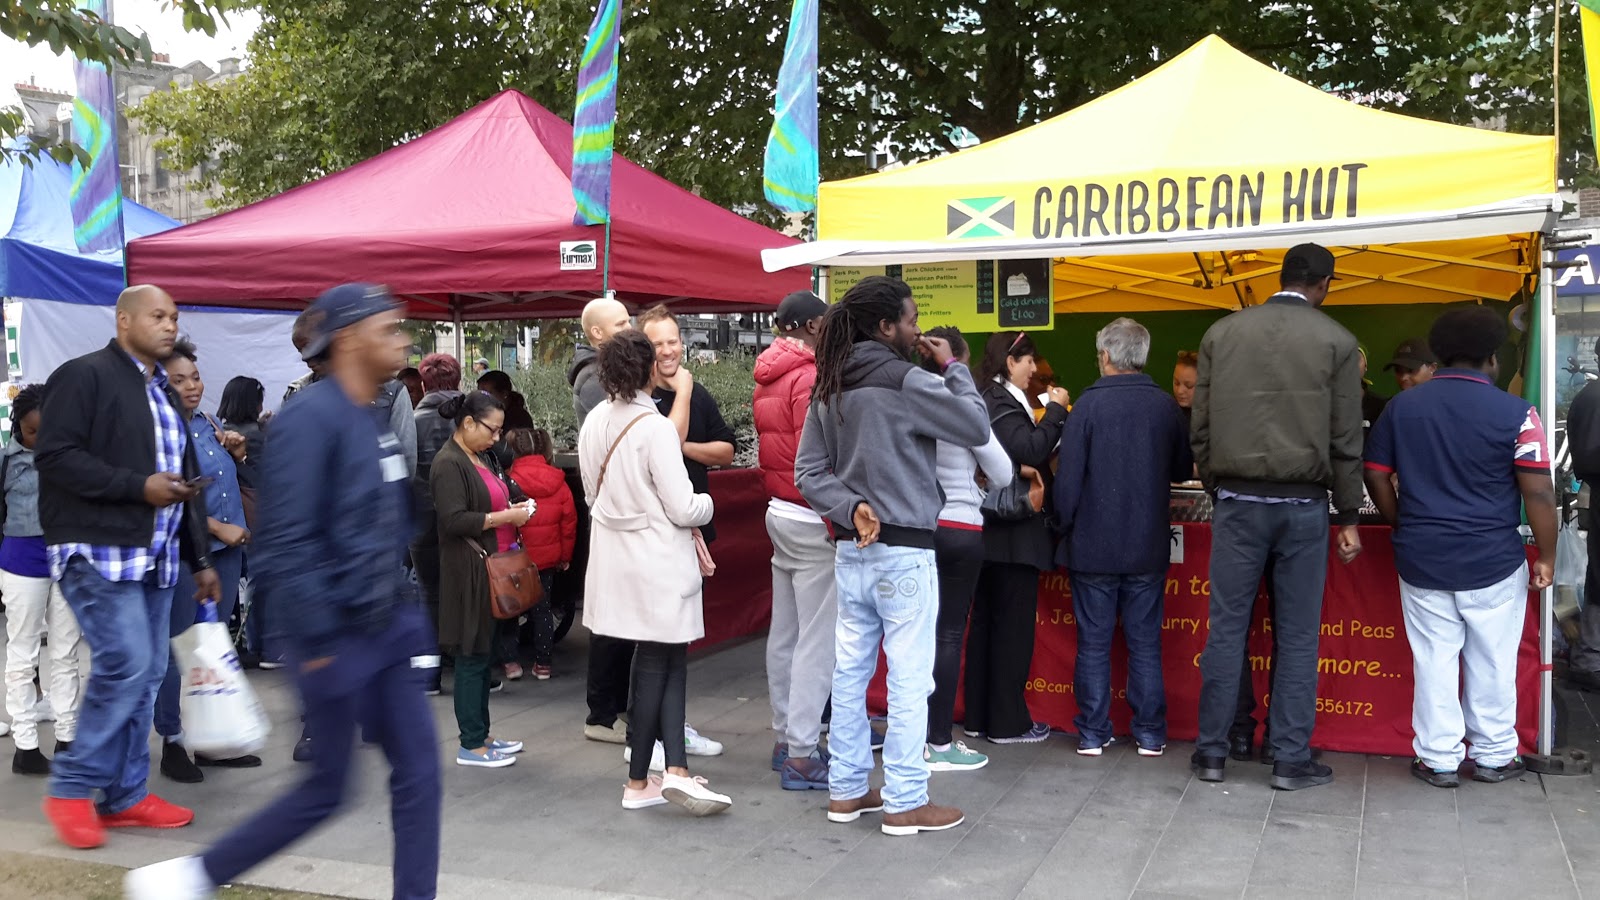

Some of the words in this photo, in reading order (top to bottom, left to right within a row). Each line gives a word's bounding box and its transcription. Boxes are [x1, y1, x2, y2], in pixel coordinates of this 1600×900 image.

[1032, 171, 1264, 240] CARIBBEAN
[1282, 163, 1368, 224] HUT
[562, 253, 592, 264] Eurmax
[1000, 298, 1019, 308] Cold
[1161, 617, 1201, 635] urry
[1318, 619, 1344, 637] nd
[1350, 619, 1395, 639] Peas
[1317, 657, 1402, 678] more...
